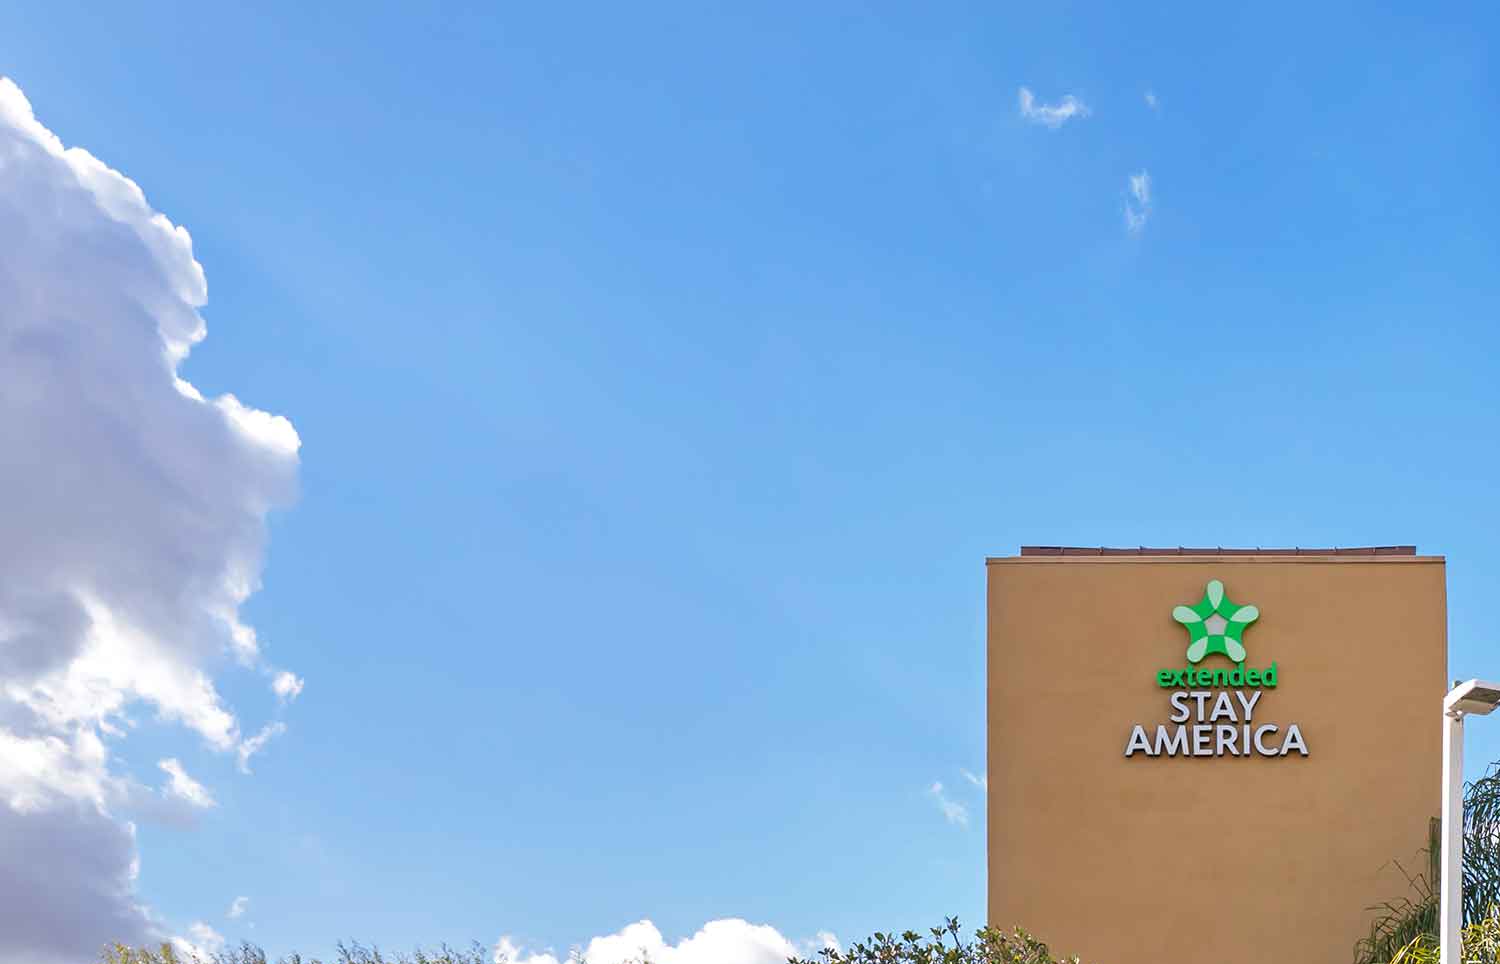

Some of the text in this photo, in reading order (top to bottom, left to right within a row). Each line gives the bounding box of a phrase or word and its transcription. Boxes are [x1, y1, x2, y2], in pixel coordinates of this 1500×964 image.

[1157, 662, 1278, 687] extended
[1170, 690, 1262, 723] STAY
[1125, 724, 1309, 756] AMERICA
